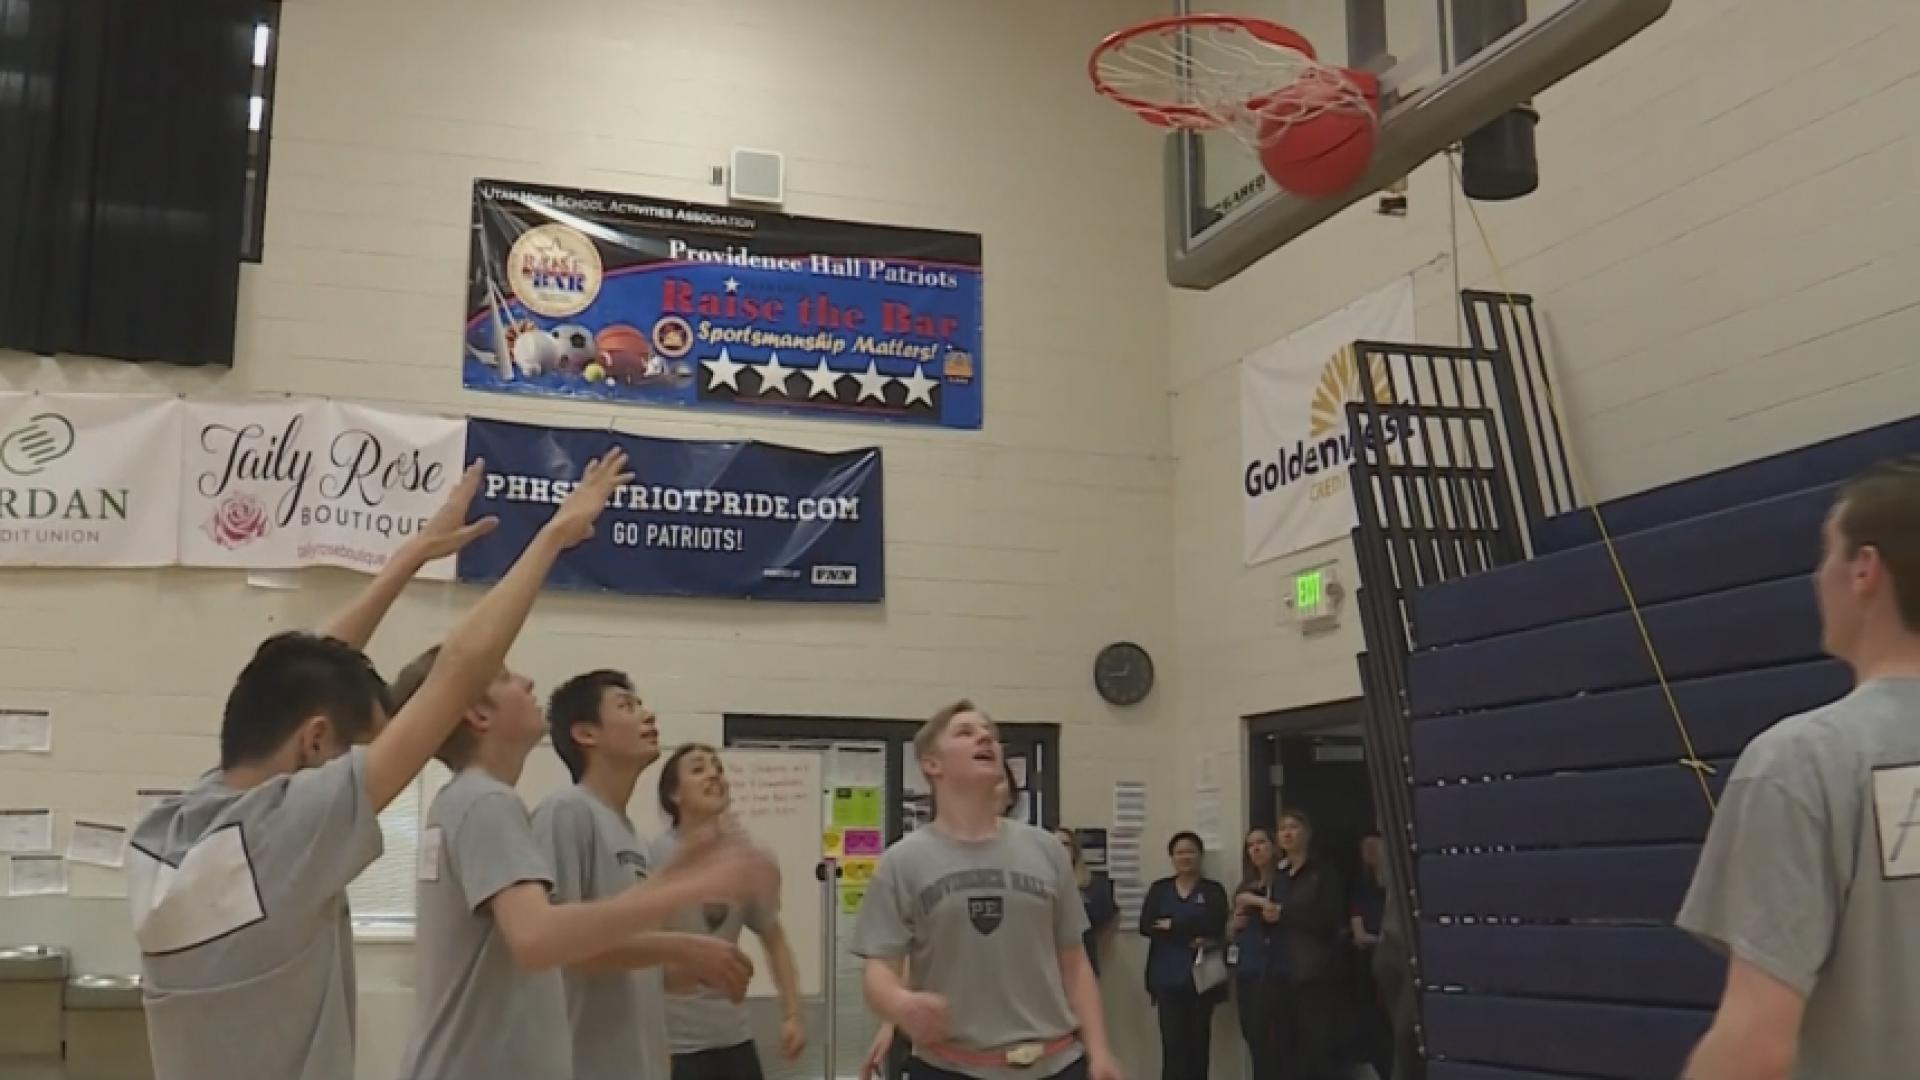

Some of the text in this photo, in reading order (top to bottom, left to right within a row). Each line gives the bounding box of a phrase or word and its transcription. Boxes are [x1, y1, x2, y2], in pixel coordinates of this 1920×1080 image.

[556, 195, 606, 213] SCHOOL
[609, 200, 673, 220] ACTIVITIES
[676, 207, 756, 229] ASSOCIATION
[668, 238, 958, 289] Providence Hall Patriots
[661, 278, 784, 321] Raise
[798, 293, 867, 330] the
[880, 300, 961, 338] Bar
[698, 320, 938, 361] Sportsmanship Matters!
[319, 429, 446, 506] Rose
[485, 472, 860, 521] PHHSTRIOTPRIDE.COM
[36, 529, 100, 544] UNION
[613, 520, 744, 552] GO PATRIOTS!
